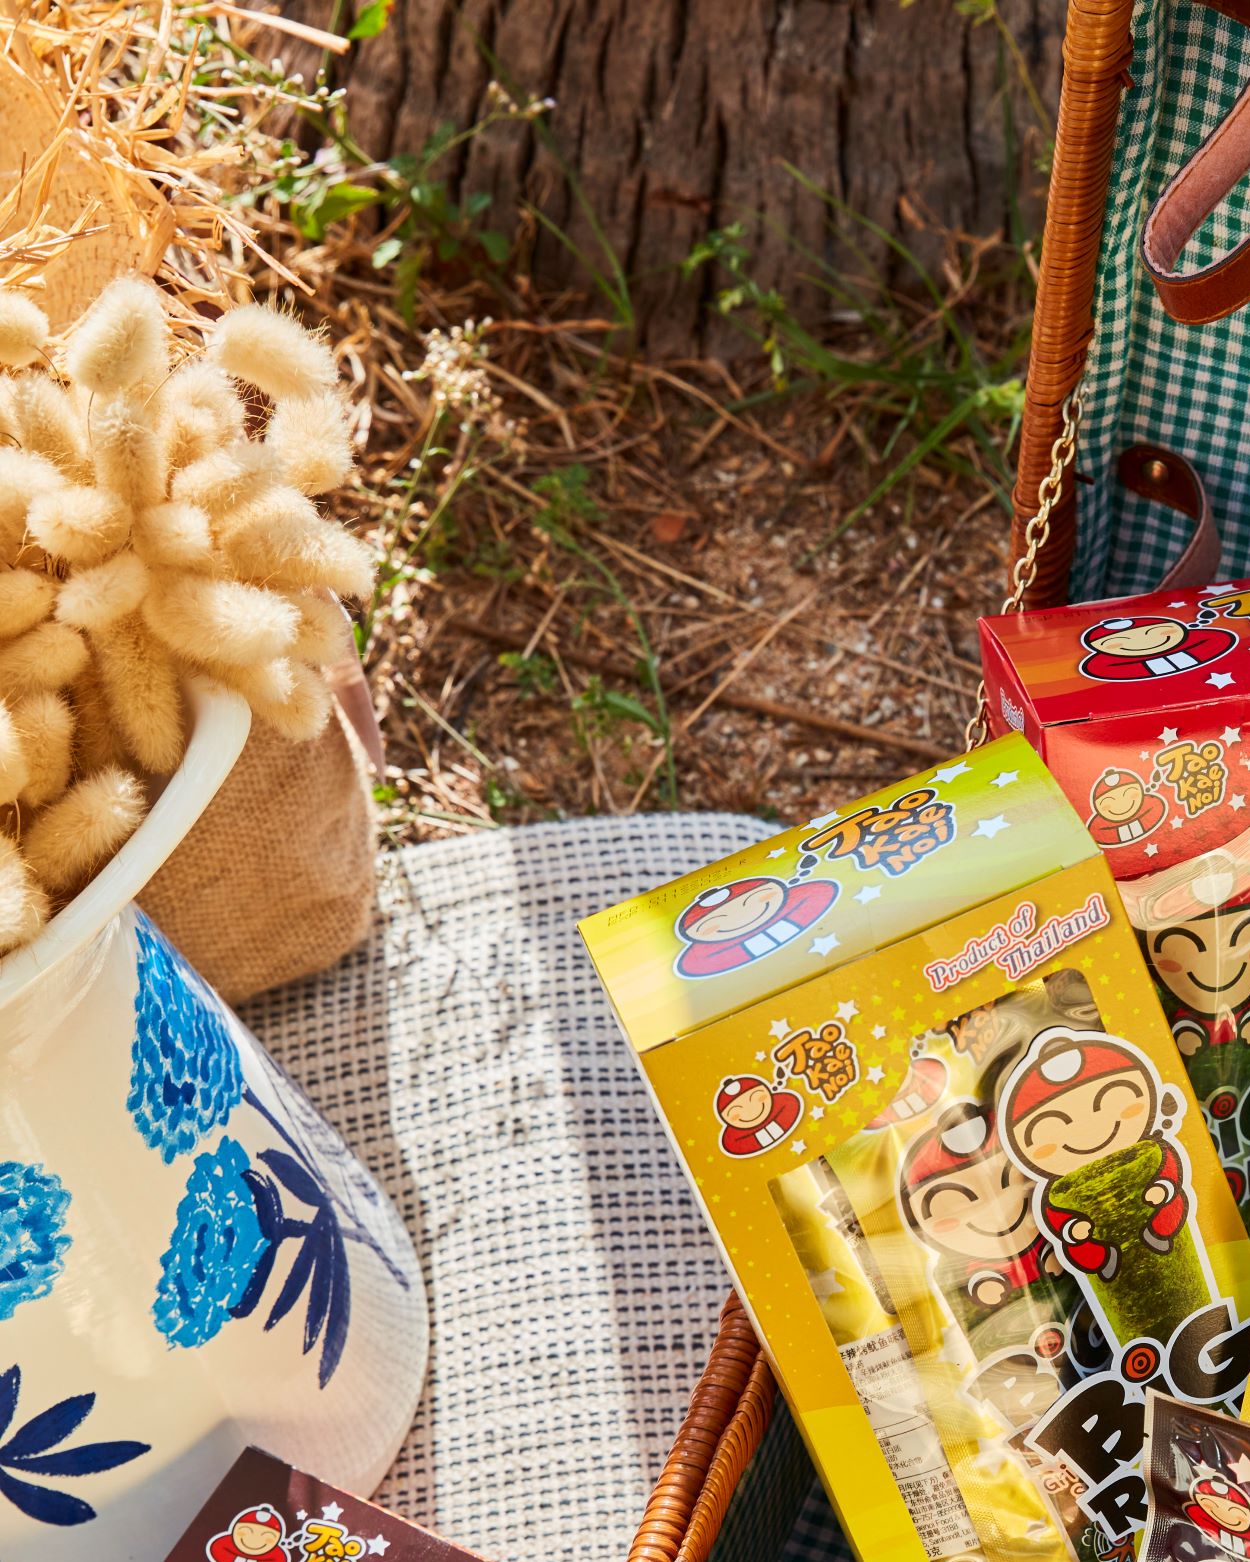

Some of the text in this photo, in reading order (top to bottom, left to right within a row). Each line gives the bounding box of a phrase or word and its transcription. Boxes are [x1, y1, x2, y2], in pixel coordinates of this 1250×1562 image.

[1158, 742, 1219, 780] Tao
[1180, 764, 1225, 801] Kae
[1186, 782, 1223, 815] Noi
[803, 789, 936, 859] Tao
[857, 804, 950, 867] Kae
[932, 908, 1032, 985] Product of
[1003, 903, 1102, 976] Thailand
[776, 1023, 841, 1074] Tao
[808, 1043, 852, 1091] Kae
[823, 1059, 857, 1100] Noi
[305, 1524, 363, 1558] Tao
